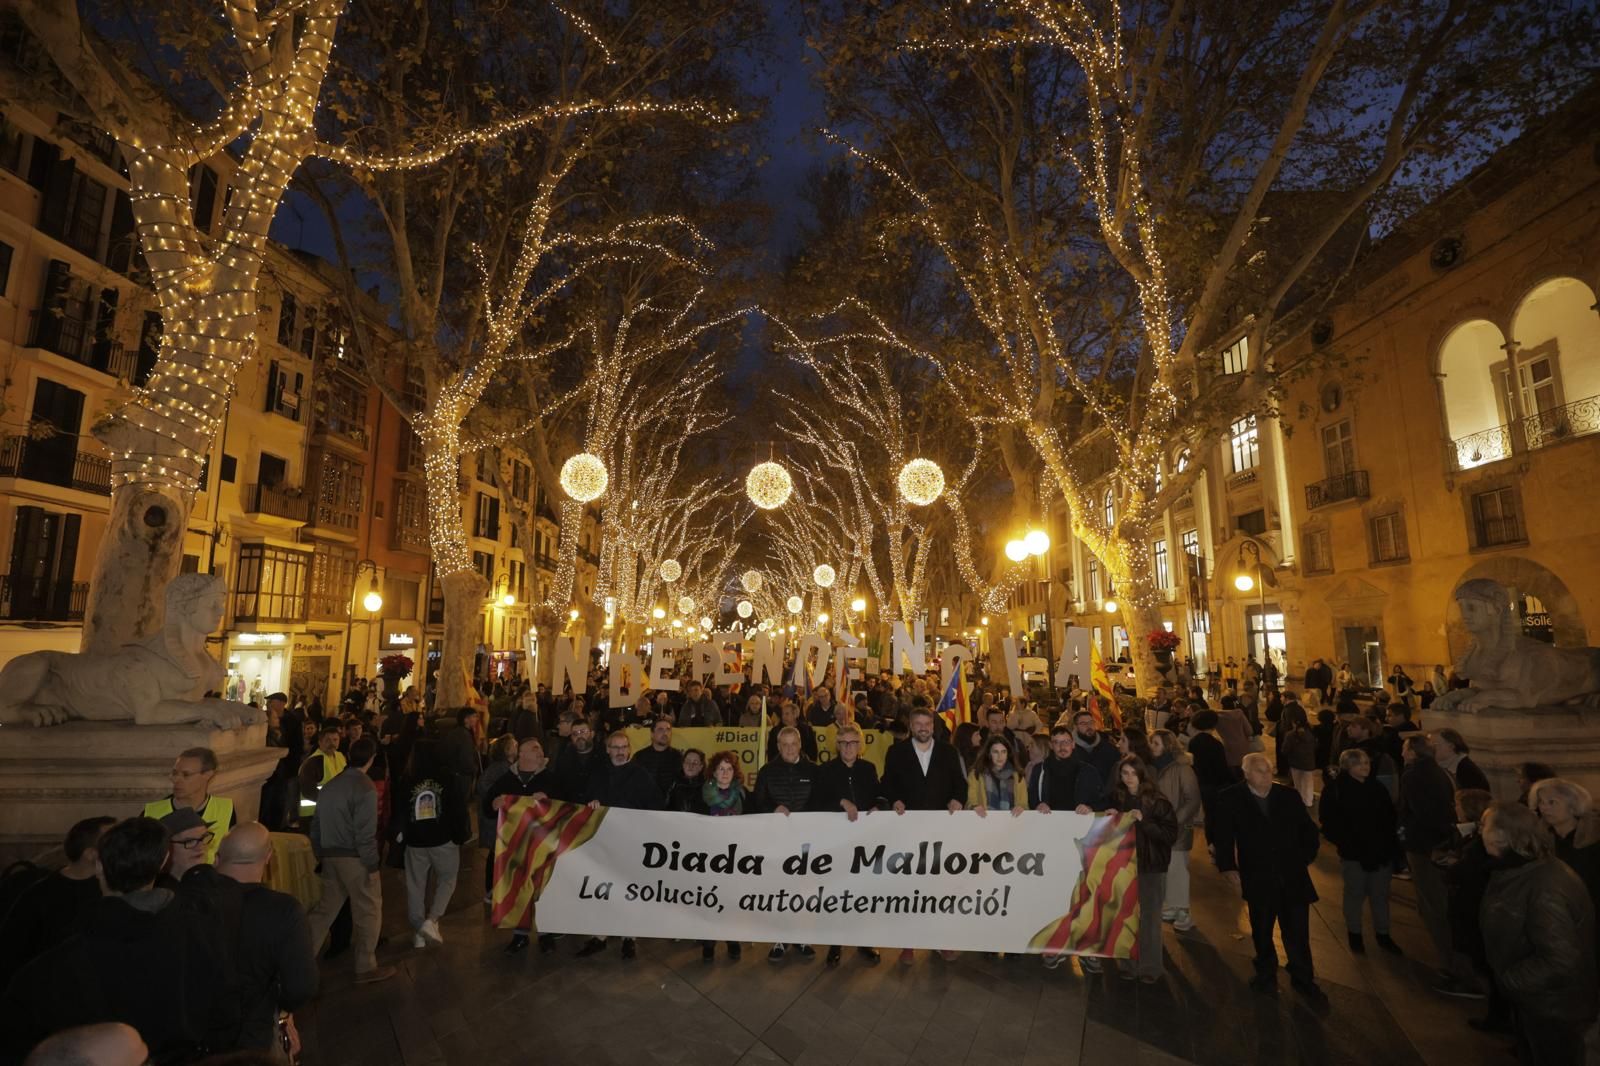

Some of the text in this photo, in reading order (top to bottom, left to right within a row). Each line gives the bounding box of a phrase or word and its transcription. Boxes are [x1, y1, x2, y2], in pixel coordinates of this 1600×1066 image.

[716, 731, 759, 743] #Diad
[642, 840, 1046, 876] Diada de Mallorca
[578, 875, 1011, 917] La solució, autodeterminació!
